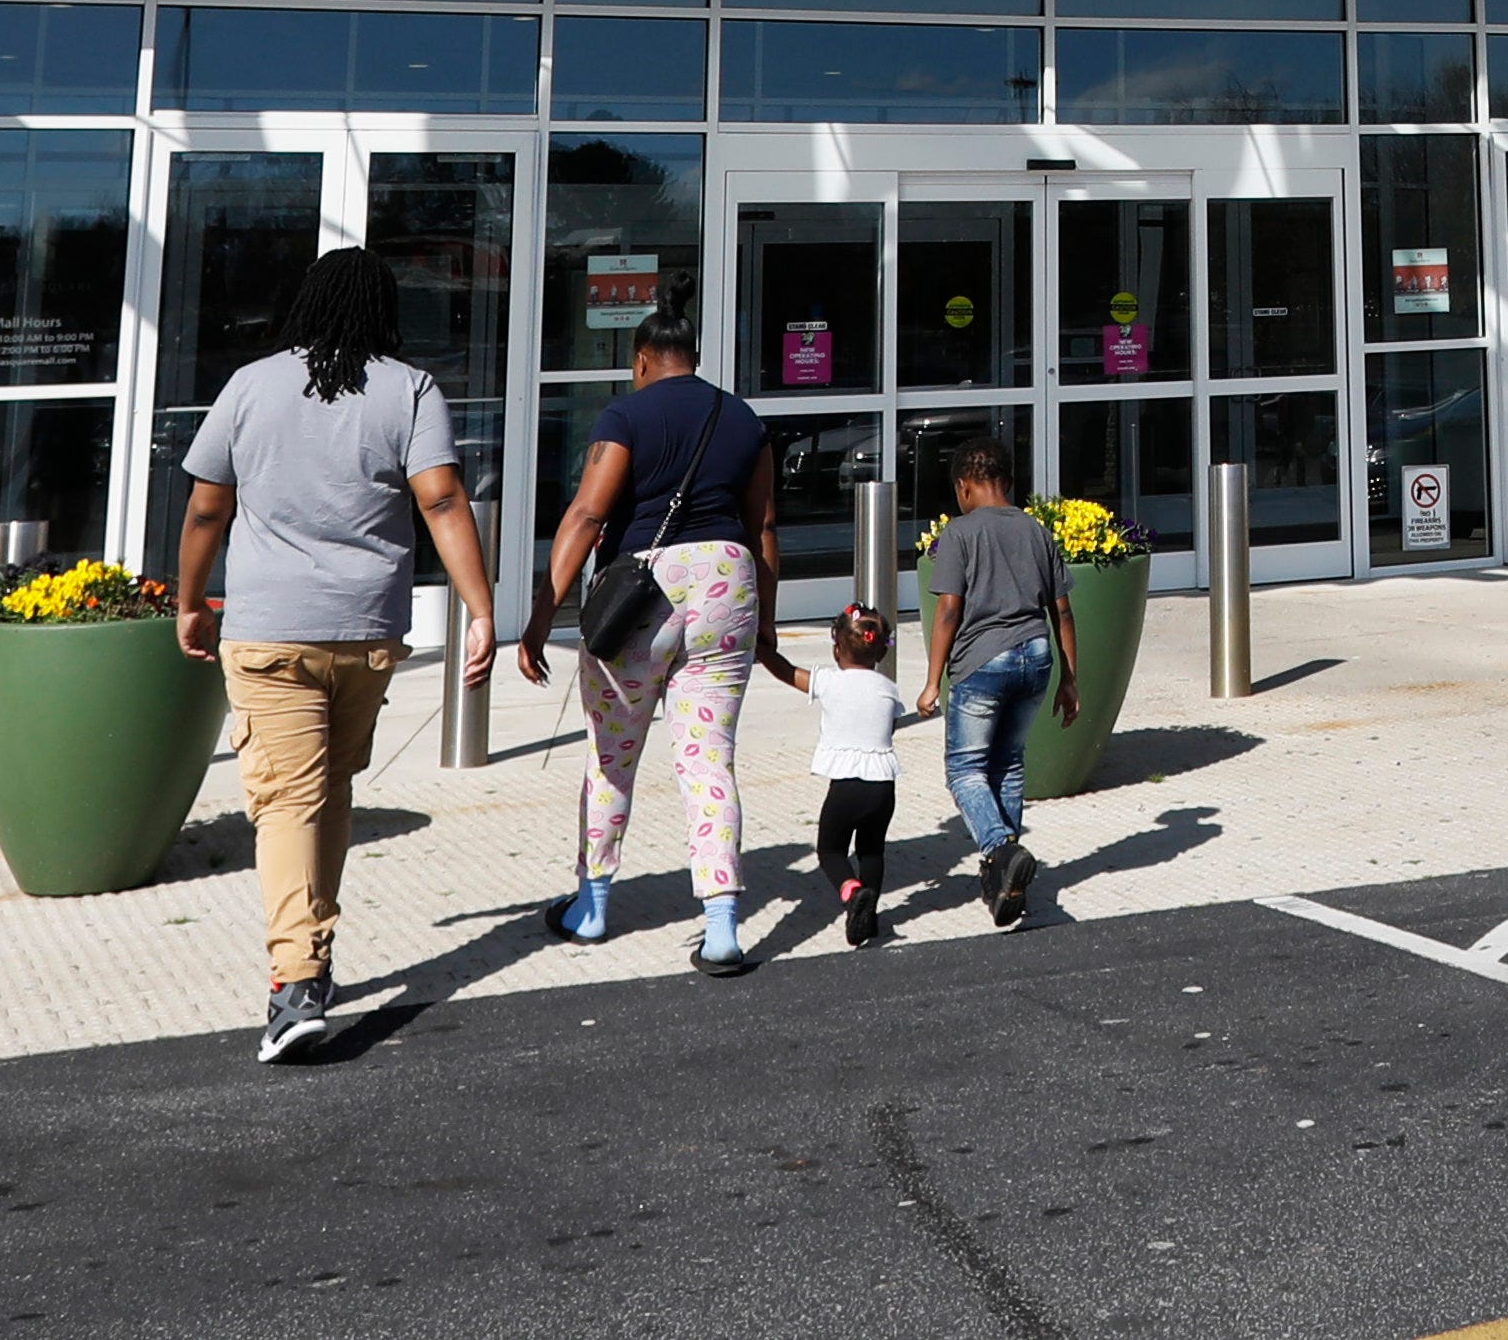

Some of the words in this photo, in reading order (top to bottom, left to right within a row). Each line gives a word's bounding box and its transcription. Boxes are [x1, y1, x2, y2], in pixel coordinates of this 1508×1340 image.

[22, 317, 62, 328] Hours
[0, 334, 24, 343] 10:00
[26, 334, 42, 342] AM
[44, 334, 55, 342] to
[56, 333, 77, 342] 9:00
[79, 332, 94, 341] PM
[23, 346, 38, 354] PM
[40, 345, 52, 353] to
[75, 344, 91, 353] PM
